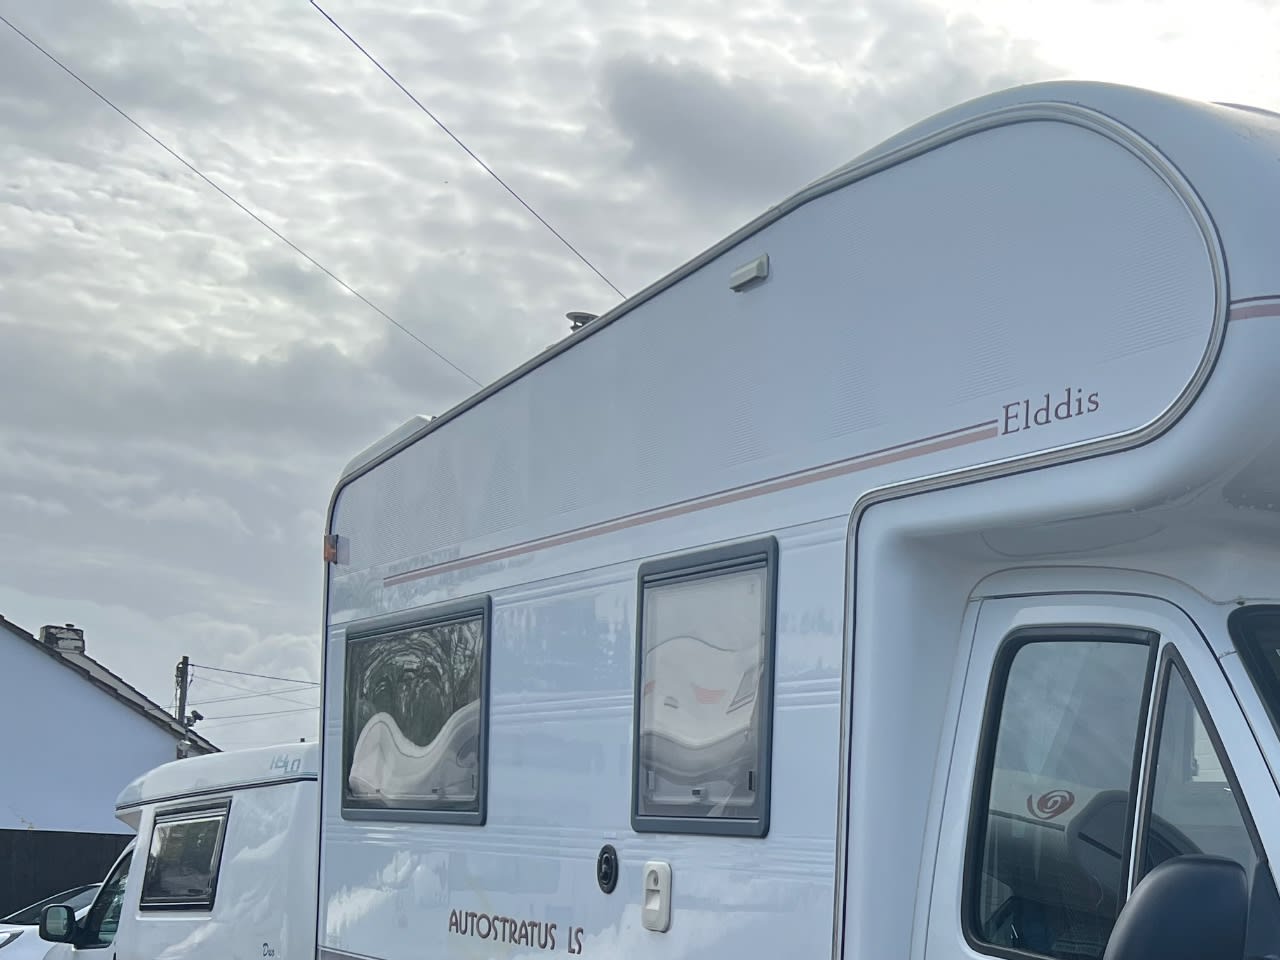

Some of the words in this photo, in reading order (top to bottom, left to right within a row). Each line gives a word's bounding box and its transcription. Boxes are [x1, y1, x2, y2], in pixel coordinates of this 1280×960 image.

[1001, 387, 1099, 435] Elddis
[449, 908, 557, 951] AUTOSTRATUS
[568, 926, 584, 955] LS
